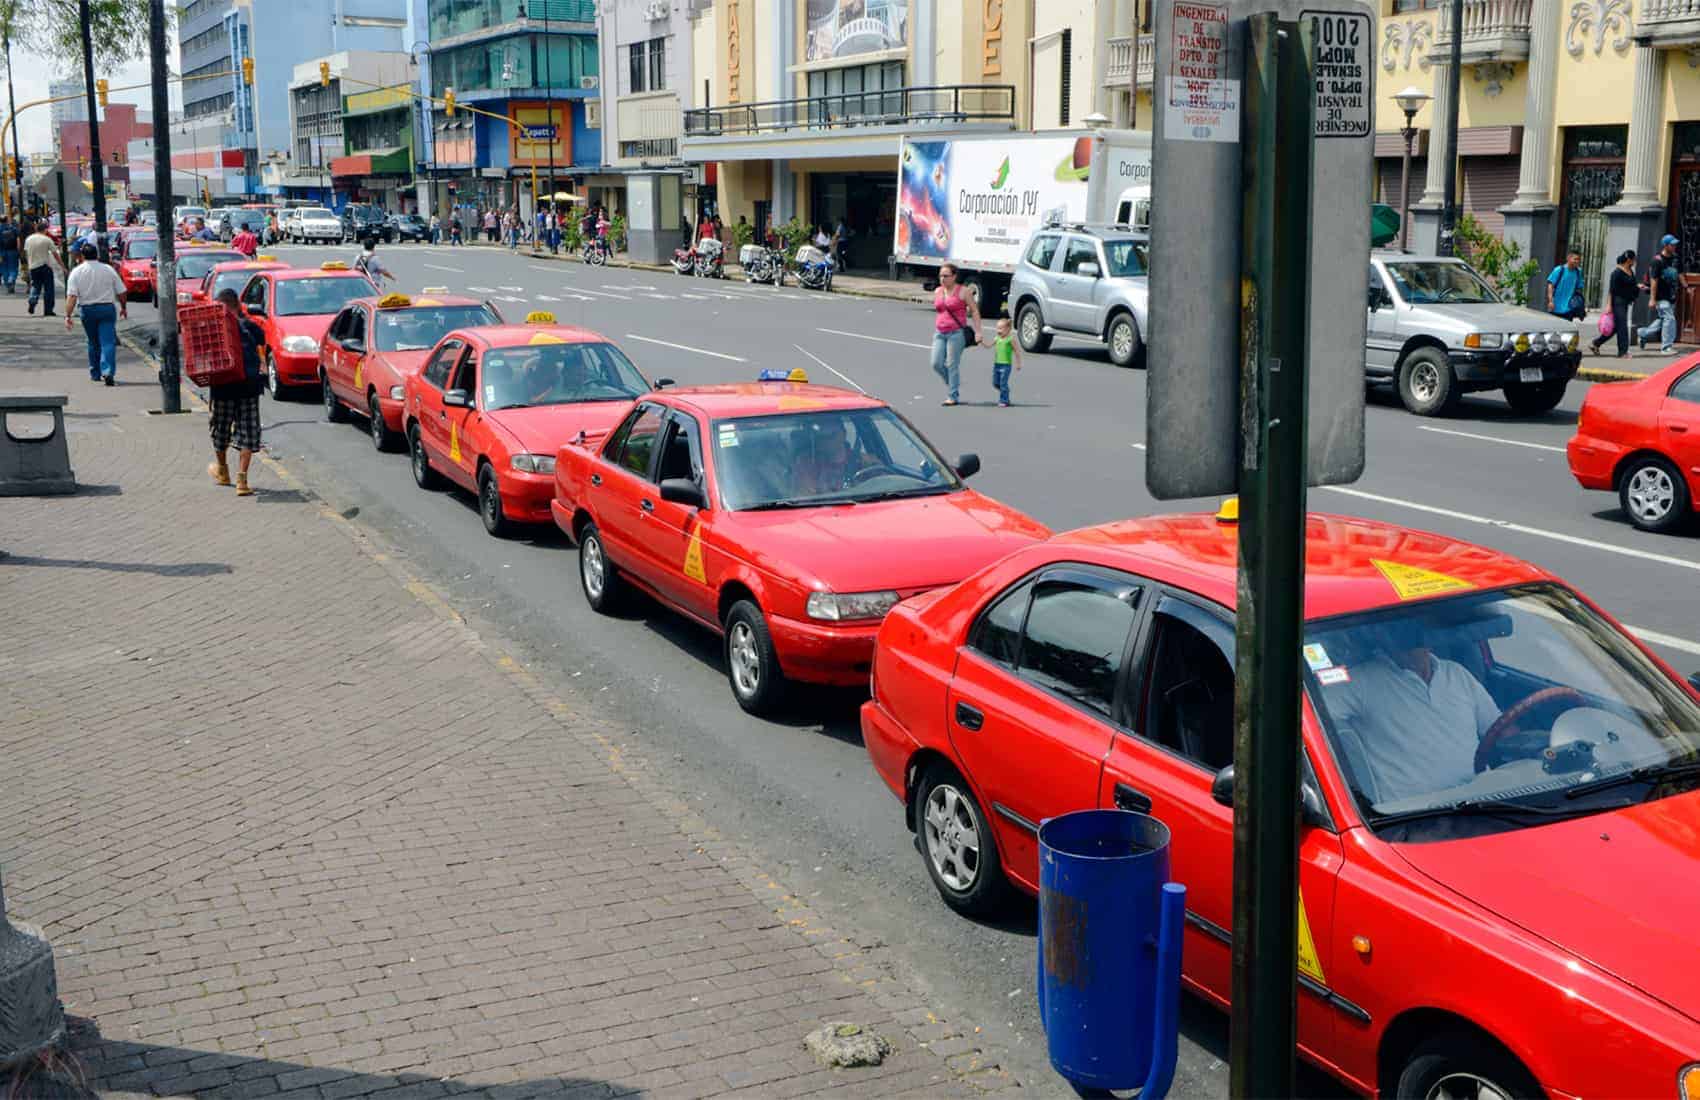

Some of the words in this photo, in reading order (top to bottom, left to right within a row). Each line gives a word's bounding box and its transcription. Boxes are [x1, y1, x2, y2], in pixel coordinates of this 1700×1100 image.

[1193, 22, 1204, 35] DE
[1178, 34, 1221, 50] TRANSITO
[728, 0, 740, 103] ACE
[1327, 109, 1342, 121] DE
[959, 187, 1019, 220] Corporación
